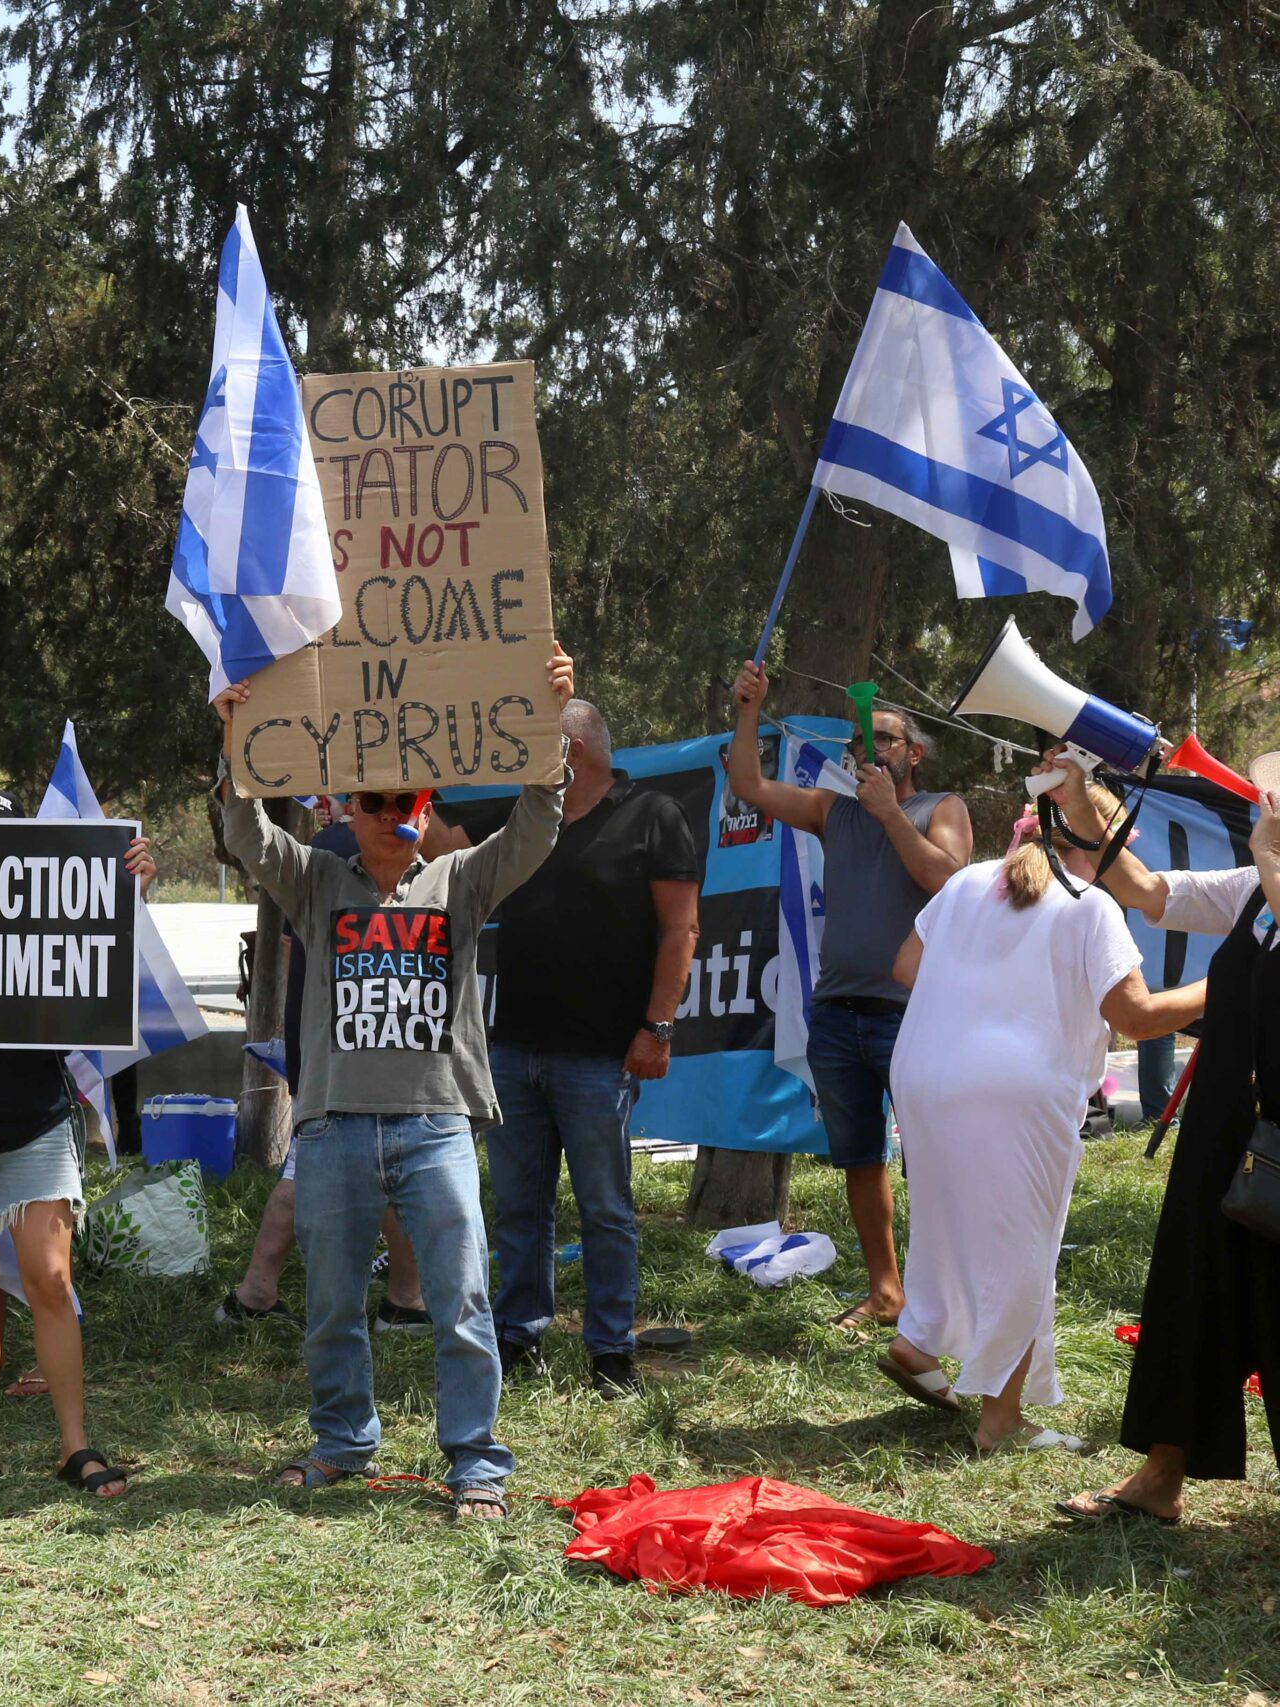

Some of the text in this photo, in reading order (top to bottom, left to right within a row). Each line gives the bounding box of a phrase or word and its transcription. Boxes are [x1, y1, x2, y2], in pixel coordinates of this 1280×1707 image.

[310, 375, 513, 443] CORUPT
[314, 441, 528, 521] TATOR
[331, 521, 480, 572] S NOT
[304, 569, 527, 647] LCOME
[362, 658, 407, 702] IN
[244, 695, 535, 788] CYPRUS
[335, 913, 449, 955] SAVE
[335, 952, 448, 980] ISRAEL'S
[336, 978, 448, 1018] DEMO
[335, 1013, 446, 1052] CRACY
